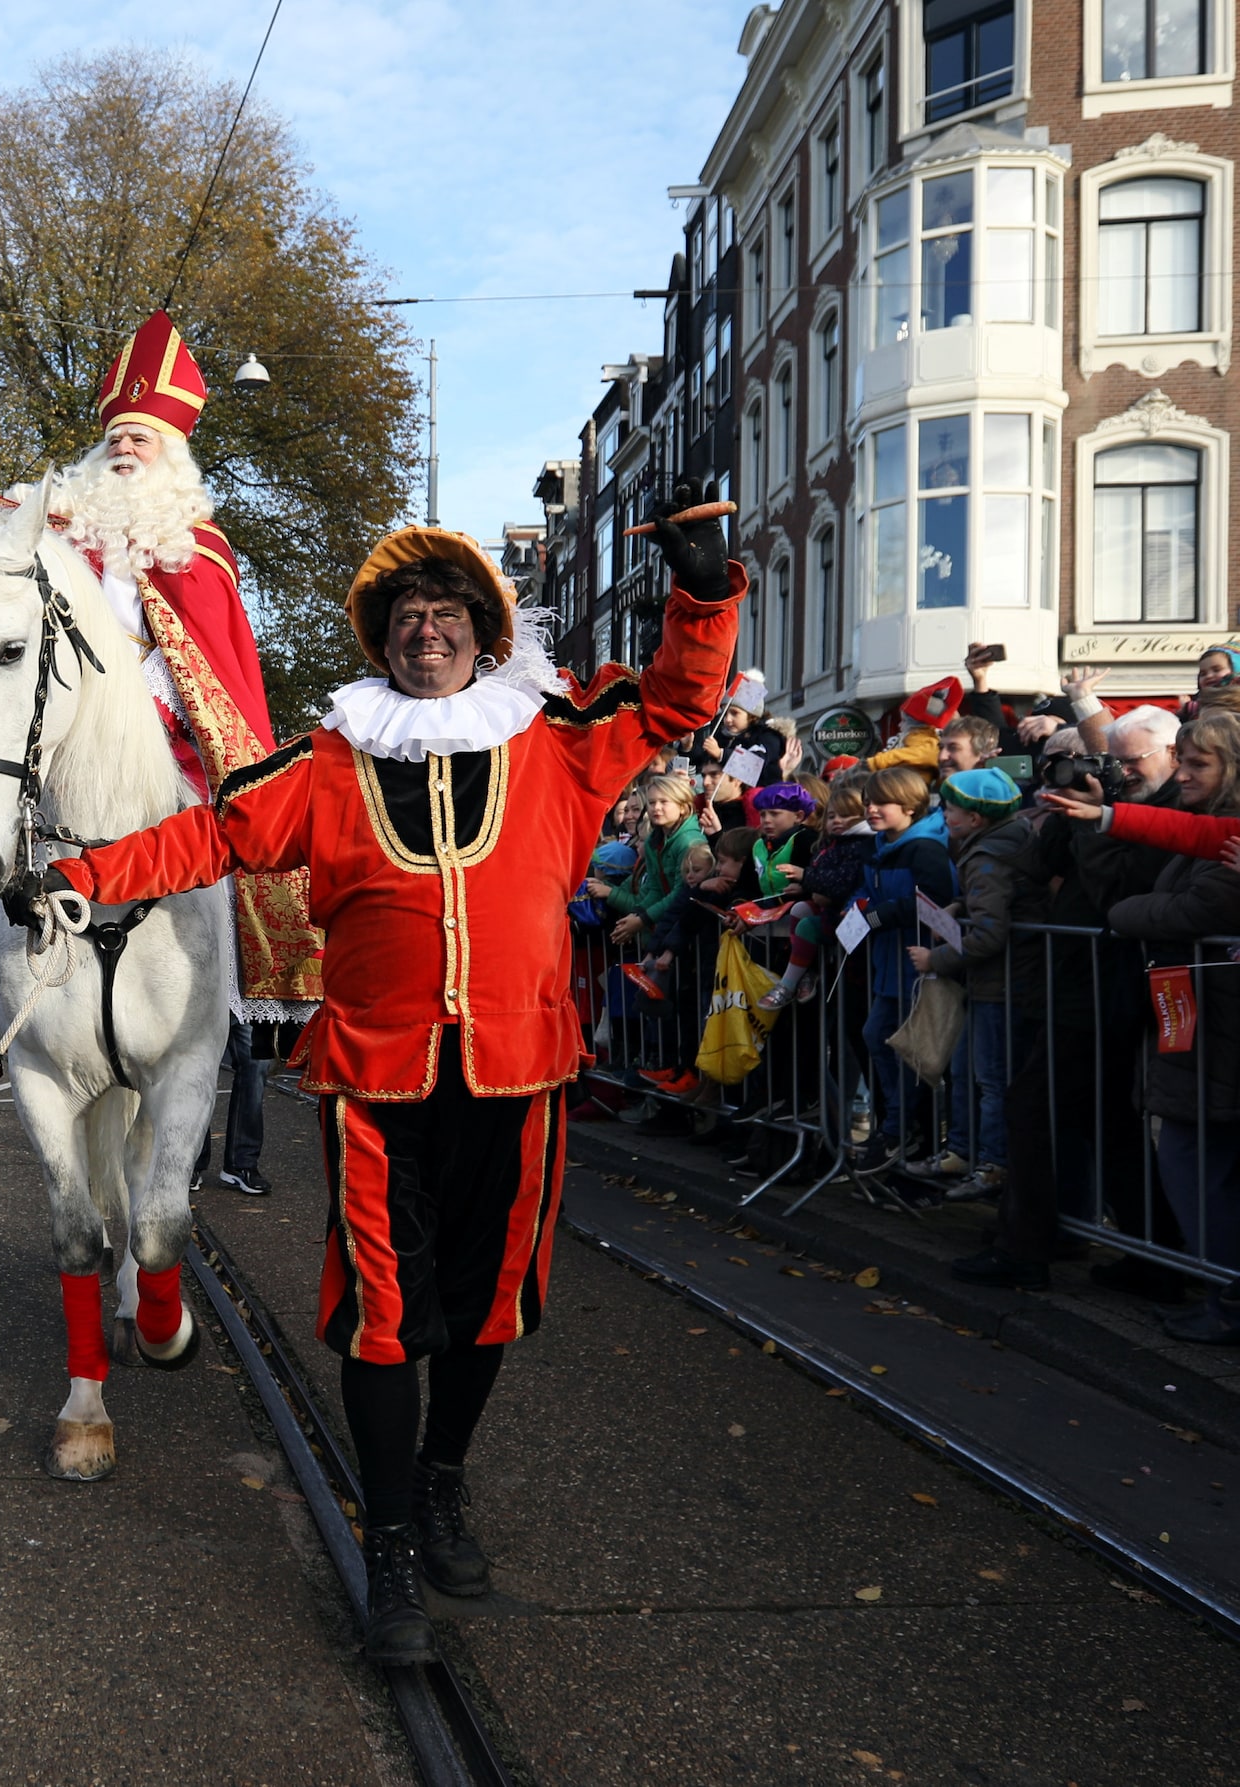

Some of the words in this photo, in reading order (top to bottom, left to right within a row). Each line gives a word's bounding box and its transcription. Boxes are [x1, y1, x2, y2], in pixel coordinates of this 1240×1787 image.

[1070, 637, 1099, 659] café
[1132, 634, 1237, 654] Hoois
[1157, 992, 1171, 1038] WELKOM
[1163, 980, 1178, 1048] SINTERKLAAS
